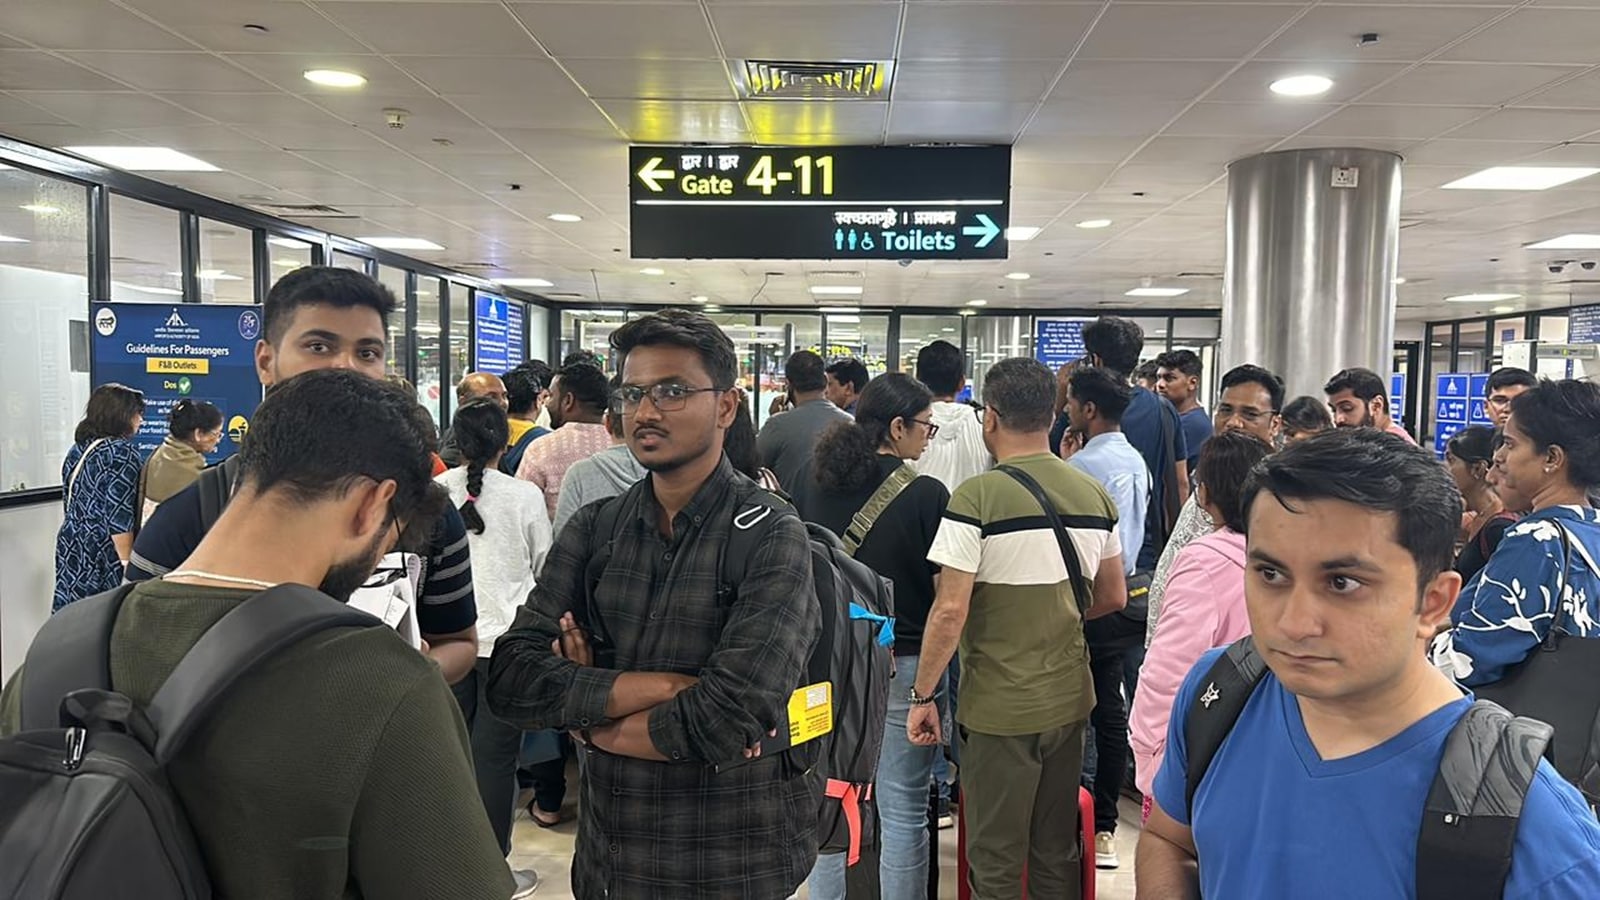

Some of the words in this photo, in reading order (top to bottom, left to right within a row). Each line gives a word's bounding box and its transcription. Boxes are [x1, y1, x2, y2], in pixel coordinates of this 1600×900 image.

[681, 175, 733, 194] Gate
[746, 155, 833, 195] 4-11
[881, 229, 956, 251] Toilets
[126, 343, 169, 354] Guidelines
[170, 344, 183, 354] For
[184, 345, 229, 357] Passengers
[173, 361, 197, 370] Outlets
[164, 381, 177, 389] Dos
